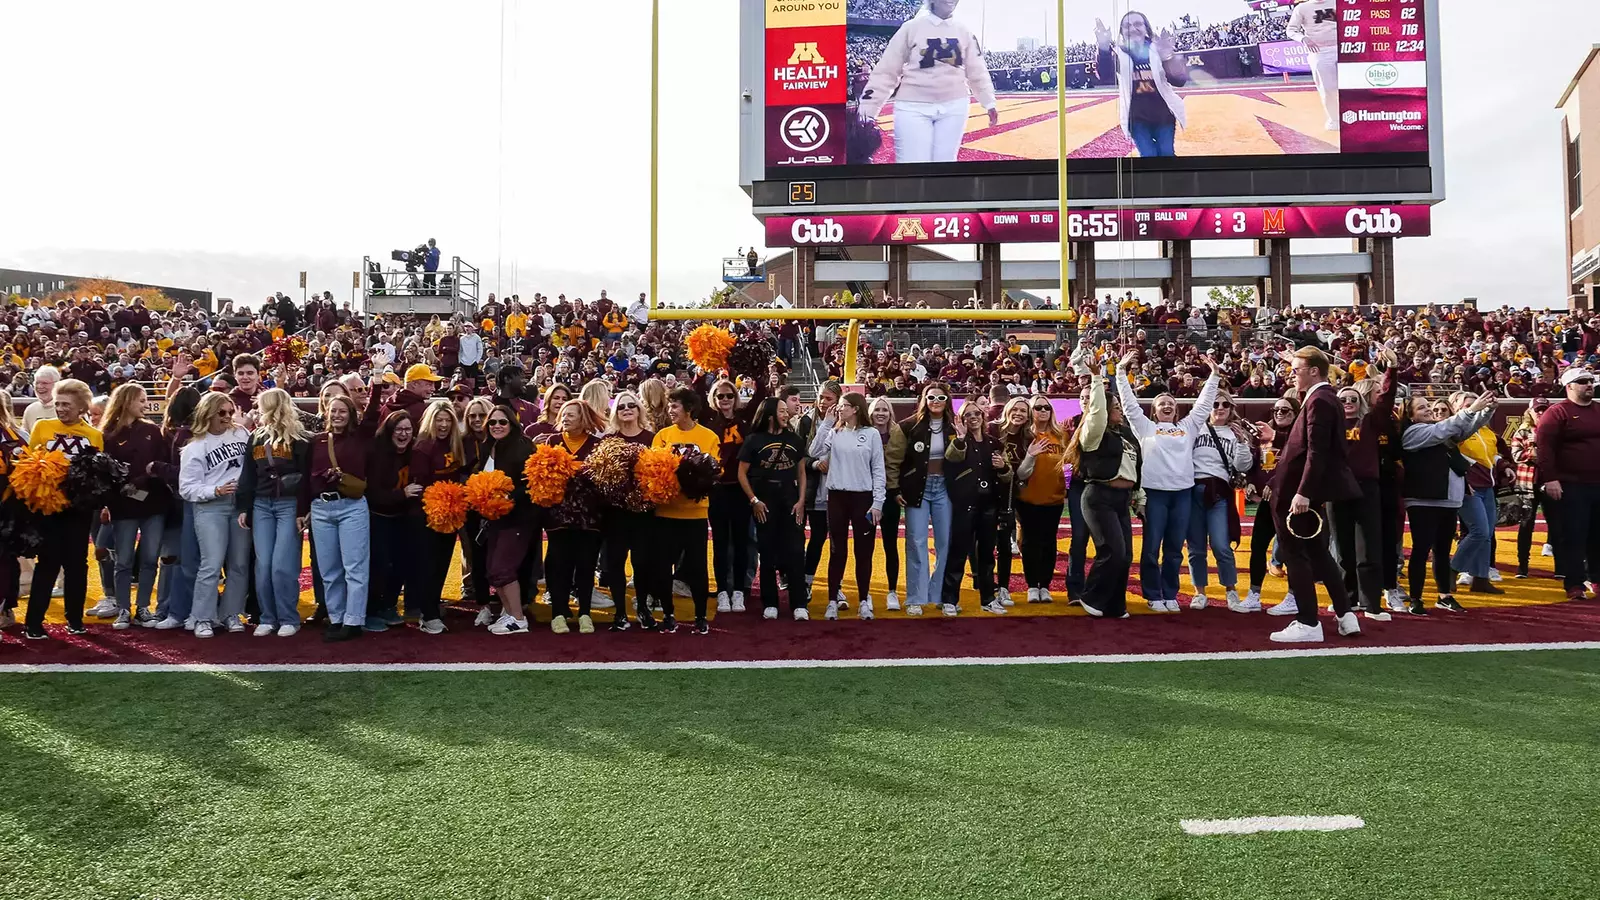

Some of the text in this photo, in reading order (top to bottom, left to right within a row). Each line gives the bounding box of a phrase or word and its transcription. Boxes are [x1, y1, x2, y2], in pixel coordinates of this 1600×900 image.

[772, 4, 815, 12] AROUND
[1343, 7, 1416, 21] 102 PASS 62
[1344, 25, 1359, 37] 99
[1369, 26, 1392, 35] TOTAL
[1340, 41, 1366, 54] 10:31
[1395, 40, 1424, 53] 12:34
[774, 65, 838, 81] HEALTH
[1368, 70, 1397, 80] bibigo
[783, 80, 828, 90] FAIRVIEW
[1358, 109, 1422, 124] Huntington
[791, 184, 813, 201] 25
[994, 215, 1019, 224] DOWN
[1030, 214, 1054, 223] TO GO
[1135, 212, 1150, 222] QTR
[1155, 211, 1187, 221] BALL ON
[1232, 211, 1247, 233] 3
[1263, 208, 1286, 231] M
[1345, 208, 1402, 234] Cub
[791, 218, 844, 243] Cub
[891, 218, 928, 240] M
[933, 217, 960, 238] 24
[1068, 213, 1118, 237] 6:55
[1139, 223, 1147, 235] 2
